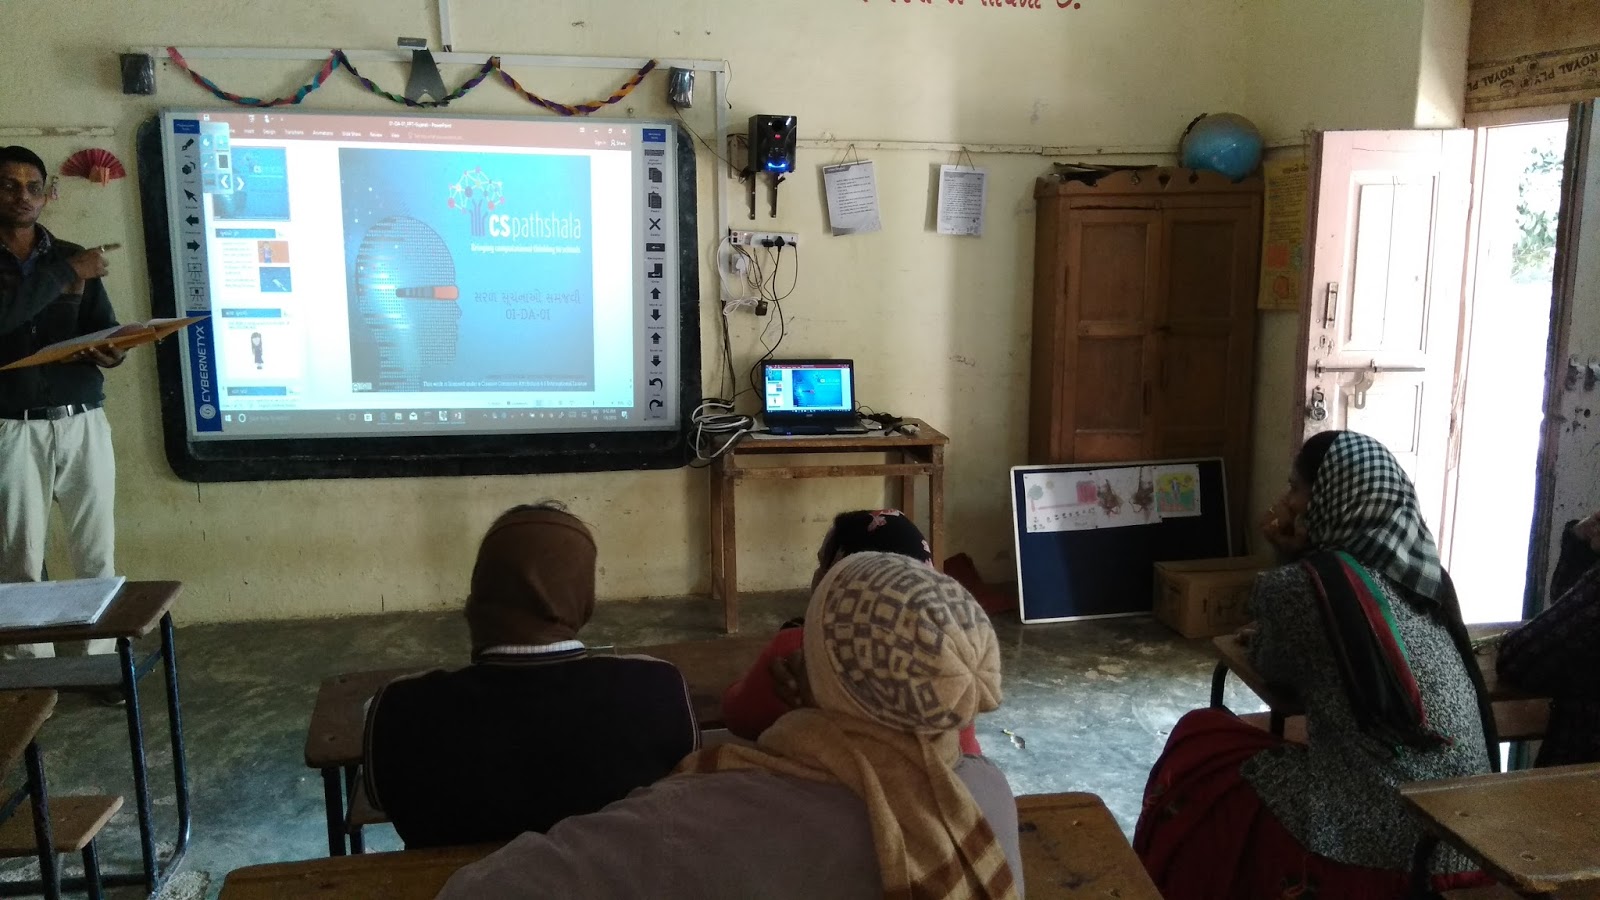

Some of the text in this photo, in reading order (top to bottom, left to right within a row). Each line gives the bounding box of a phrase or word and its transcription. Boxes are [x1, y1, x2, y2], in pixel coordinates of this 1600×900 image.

[1558, 51, 1600, 75] ROYAL
[1467, 64, 1516, 92] ROYAL PL
[489, 212, 582, 241] CS pathshala
[195, 325, 211, 402] CYBERNETYX
